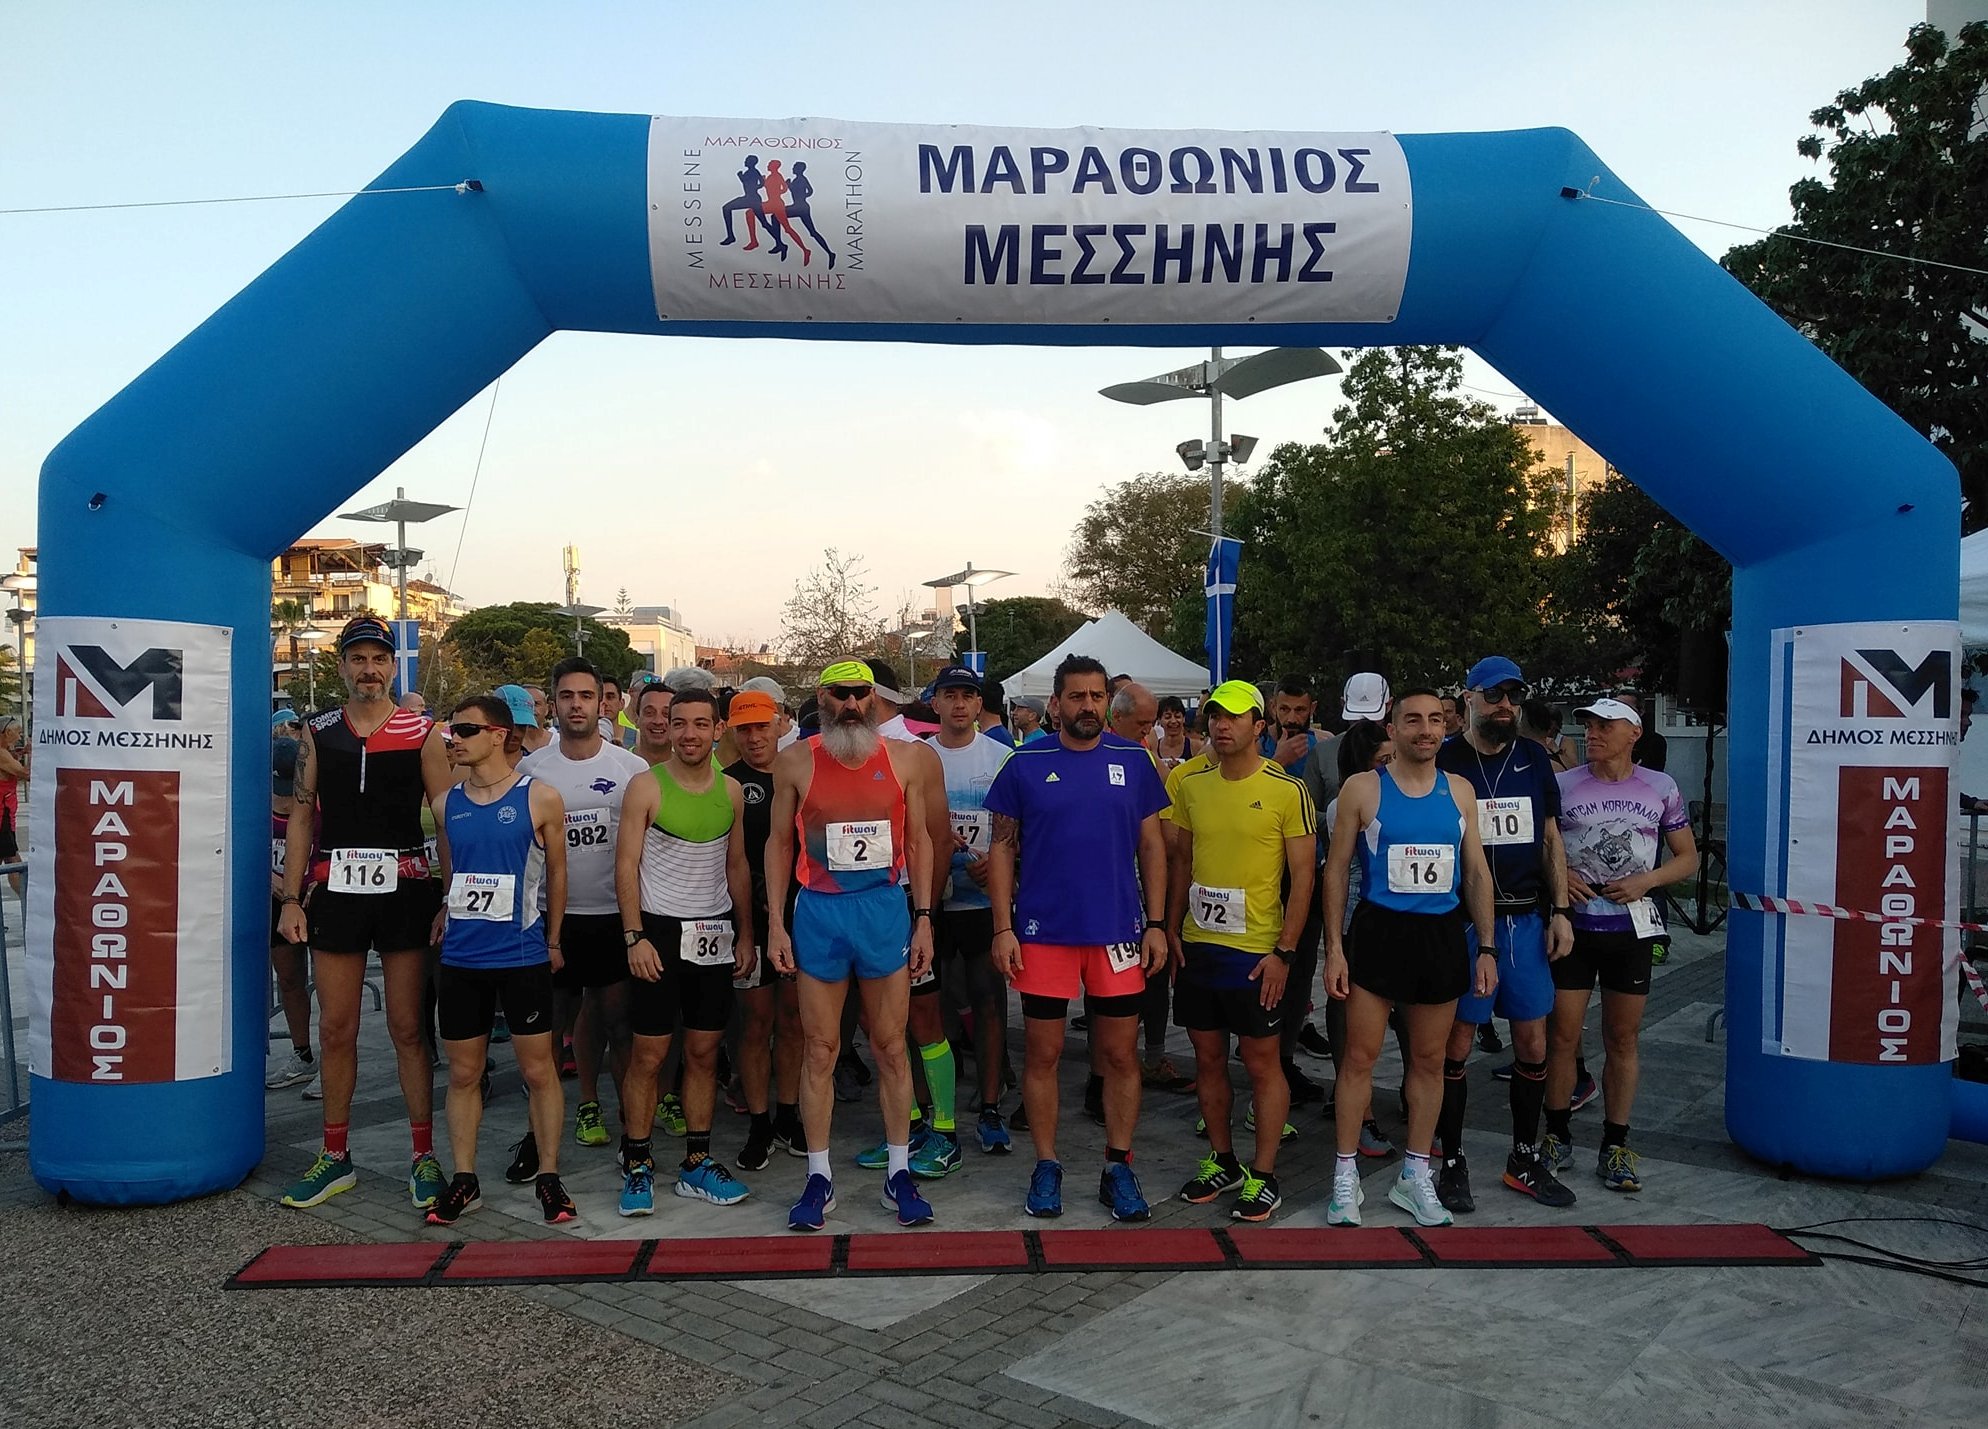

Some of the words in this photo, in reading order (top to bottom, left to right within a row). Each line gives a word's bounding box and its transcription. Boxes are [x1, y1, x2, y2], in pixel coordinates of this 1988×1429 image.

[704, 135, 844, 150] ΜΑΡΑΘΩΝΙΟΣ
[917, 142, 1382, 195] ΜΑΡΑΘΩΝΙΟΣ
[683, 148, 705, 269] MESSENE
[845, 150, 864, 271] MARATHON
[963, 220, 1337, 286] ΜΕΣΣΗΝΗΣ
[708, 272, 847, 291] ΜΕΣΣΗΝΗΣ
[39, 729, 92, 747] ΔΗΜΟΣ
[96, 730, 214, 750] ΜΕΣΣΗΝΗΣ
[1806, 729, 1884, 745] ΔΗΜΟΣ
[1486, 800, 1521, 811] fitway
[563, 812, 598, 825] itway
[949, 811, 978, 824] itway
[1491, 814, 1519, 837] 10
[567, 824, 609, 848] 982
[842, 824, 878, 836] fitway
[346, 850, 384, 862] fitway
[853, 839, 868, 862] 2
[1404, 846, 1441, 859] fitway
[343, 865, 385, 887] 116
[464, 874, 500, 888] fitway
[1409, 862, 1438, 885] 16
[466, 890, 495, 912] 27
[1201, 901, 1227, 924] 72
[1877, 776, 1920, 1062] ΜΑΡΑΘΩΝΙΟΣ
[89, 779, 134, 1081] ΜΑΡΑΘΩΝΙΟΣ
[695, 922, 724, 932] fitway
[697, 936, 720, 957] 36
